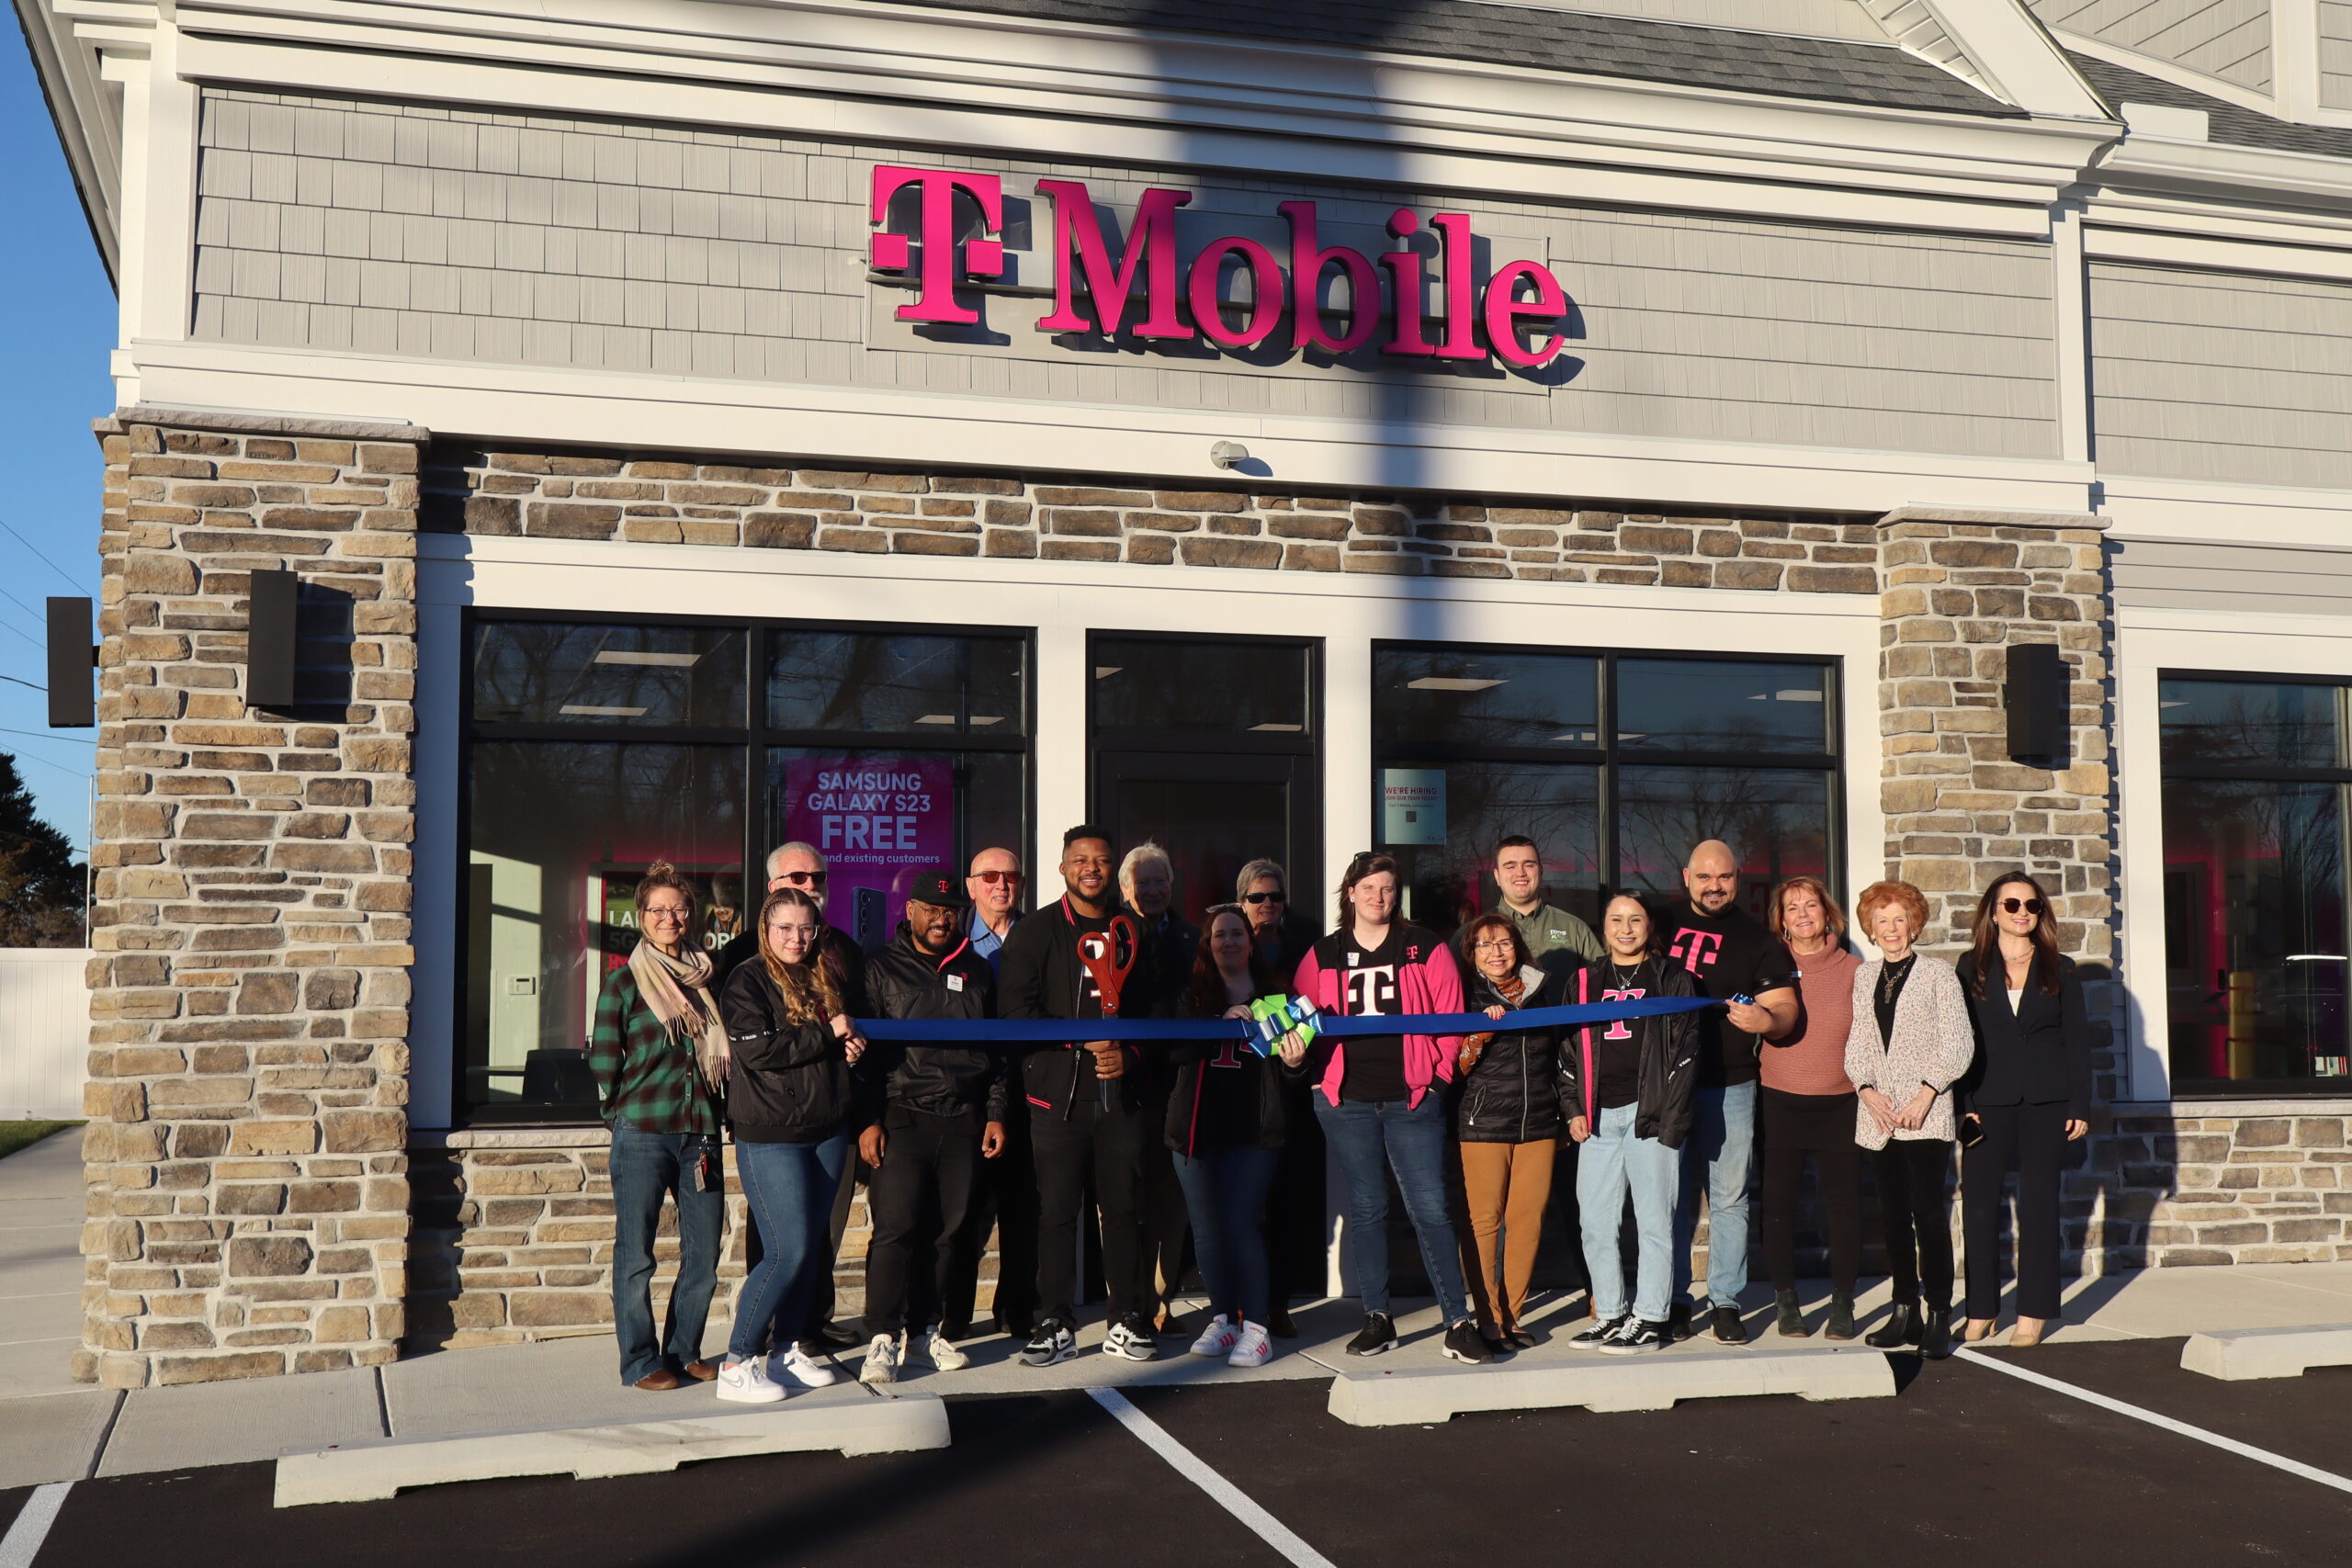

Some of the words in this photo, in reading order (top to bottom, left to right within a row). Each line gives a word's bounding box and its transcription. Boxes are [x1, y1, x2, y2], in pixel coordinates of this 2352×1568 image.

[1035, 177, 1566, 367] Mobile
[818, 772, 922, 791] SAMSUNG
[1385, 786, 1408, 795] WE'RE
[808, 793, 890, 812] GALAXY
[895, 794, 931, 812] S23
[821, 815, 917, 850] FREE
[823, 852, 842, 863] and
[843, 853, 885, 864] existing
[887, 854, 940, 863] customers
[937, 880, 949, 893] T
[1406, 945, 1419, 960] T
[1668, 927, 1724, 979] T
[1348, 964, 1395, 1016] T
